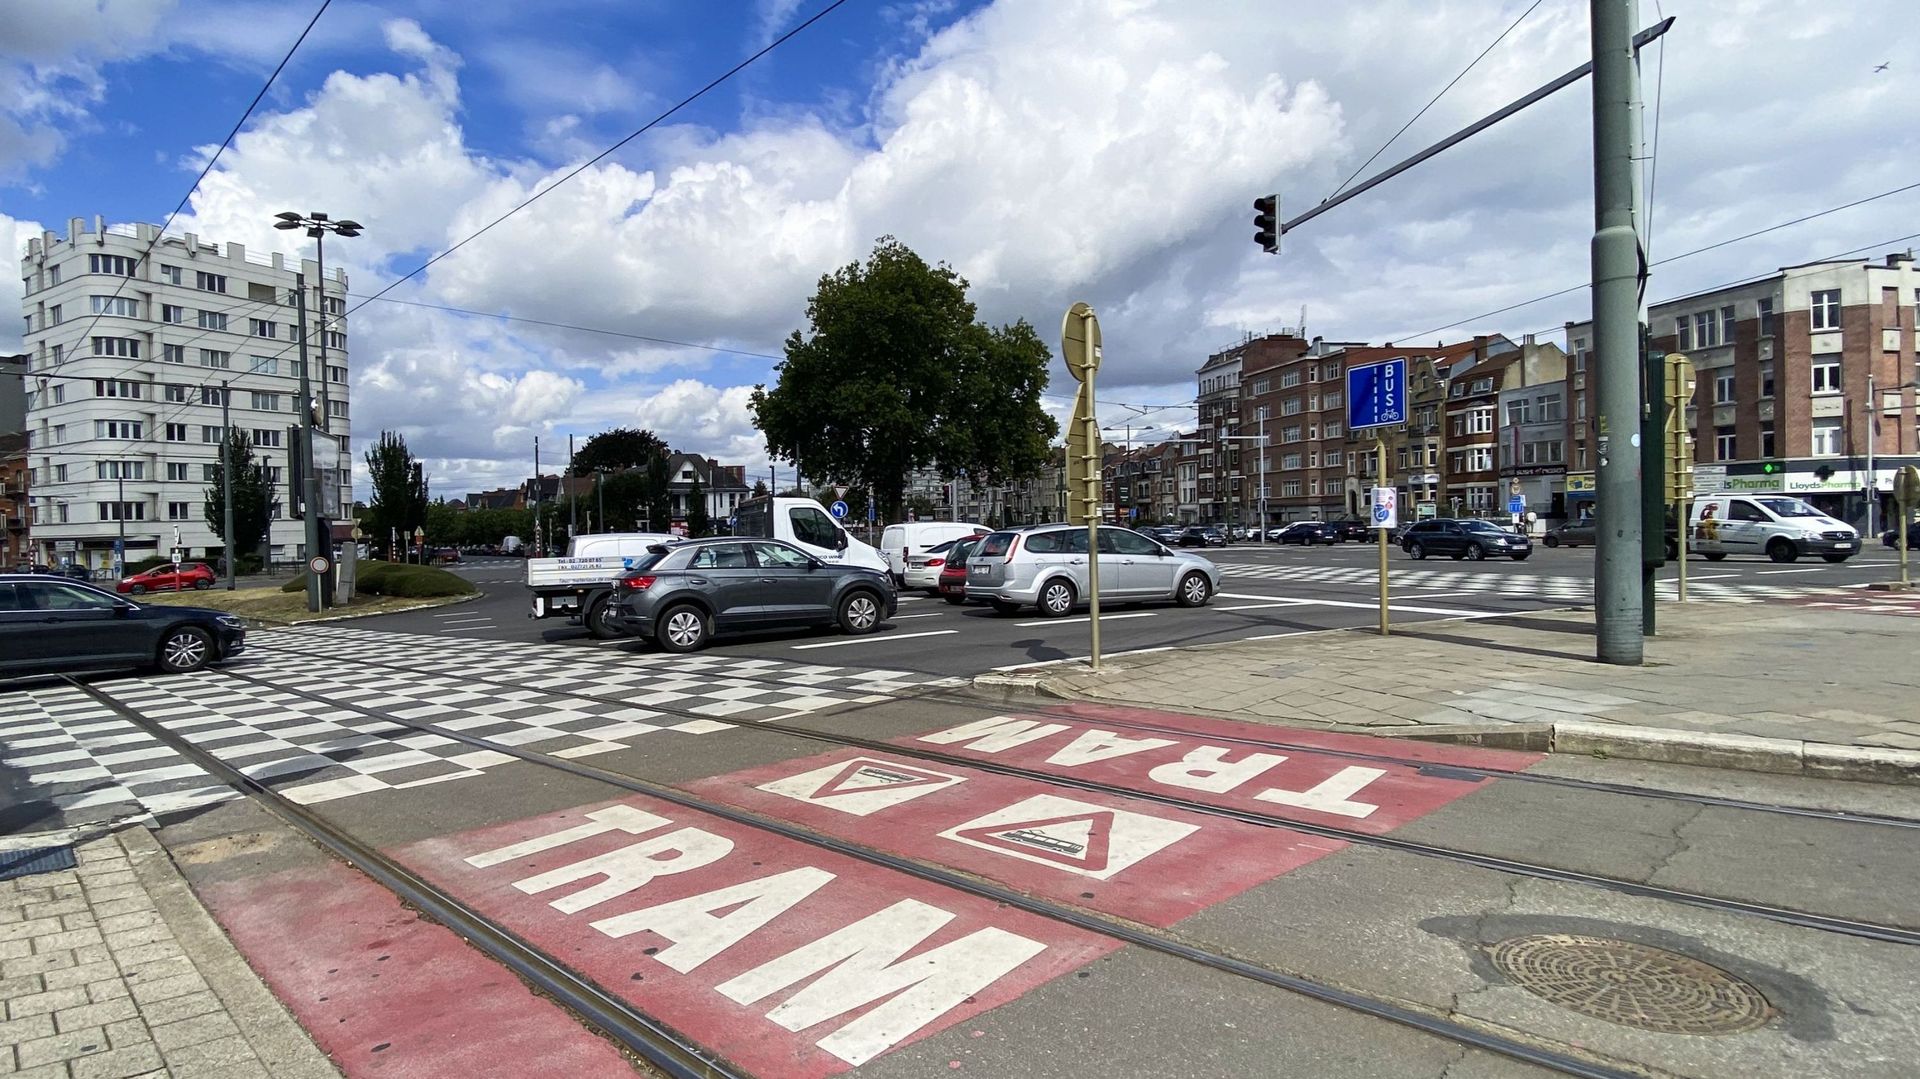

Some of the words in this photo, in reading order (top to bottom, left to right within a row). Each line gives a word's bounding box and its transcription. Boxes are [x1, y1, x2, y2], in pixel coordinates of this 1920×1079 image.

[1385, 365, 1395, 406] BUS
[916, 716, 1387, 819] TRAM
[463, 804, 1048, 1067] TRAM
